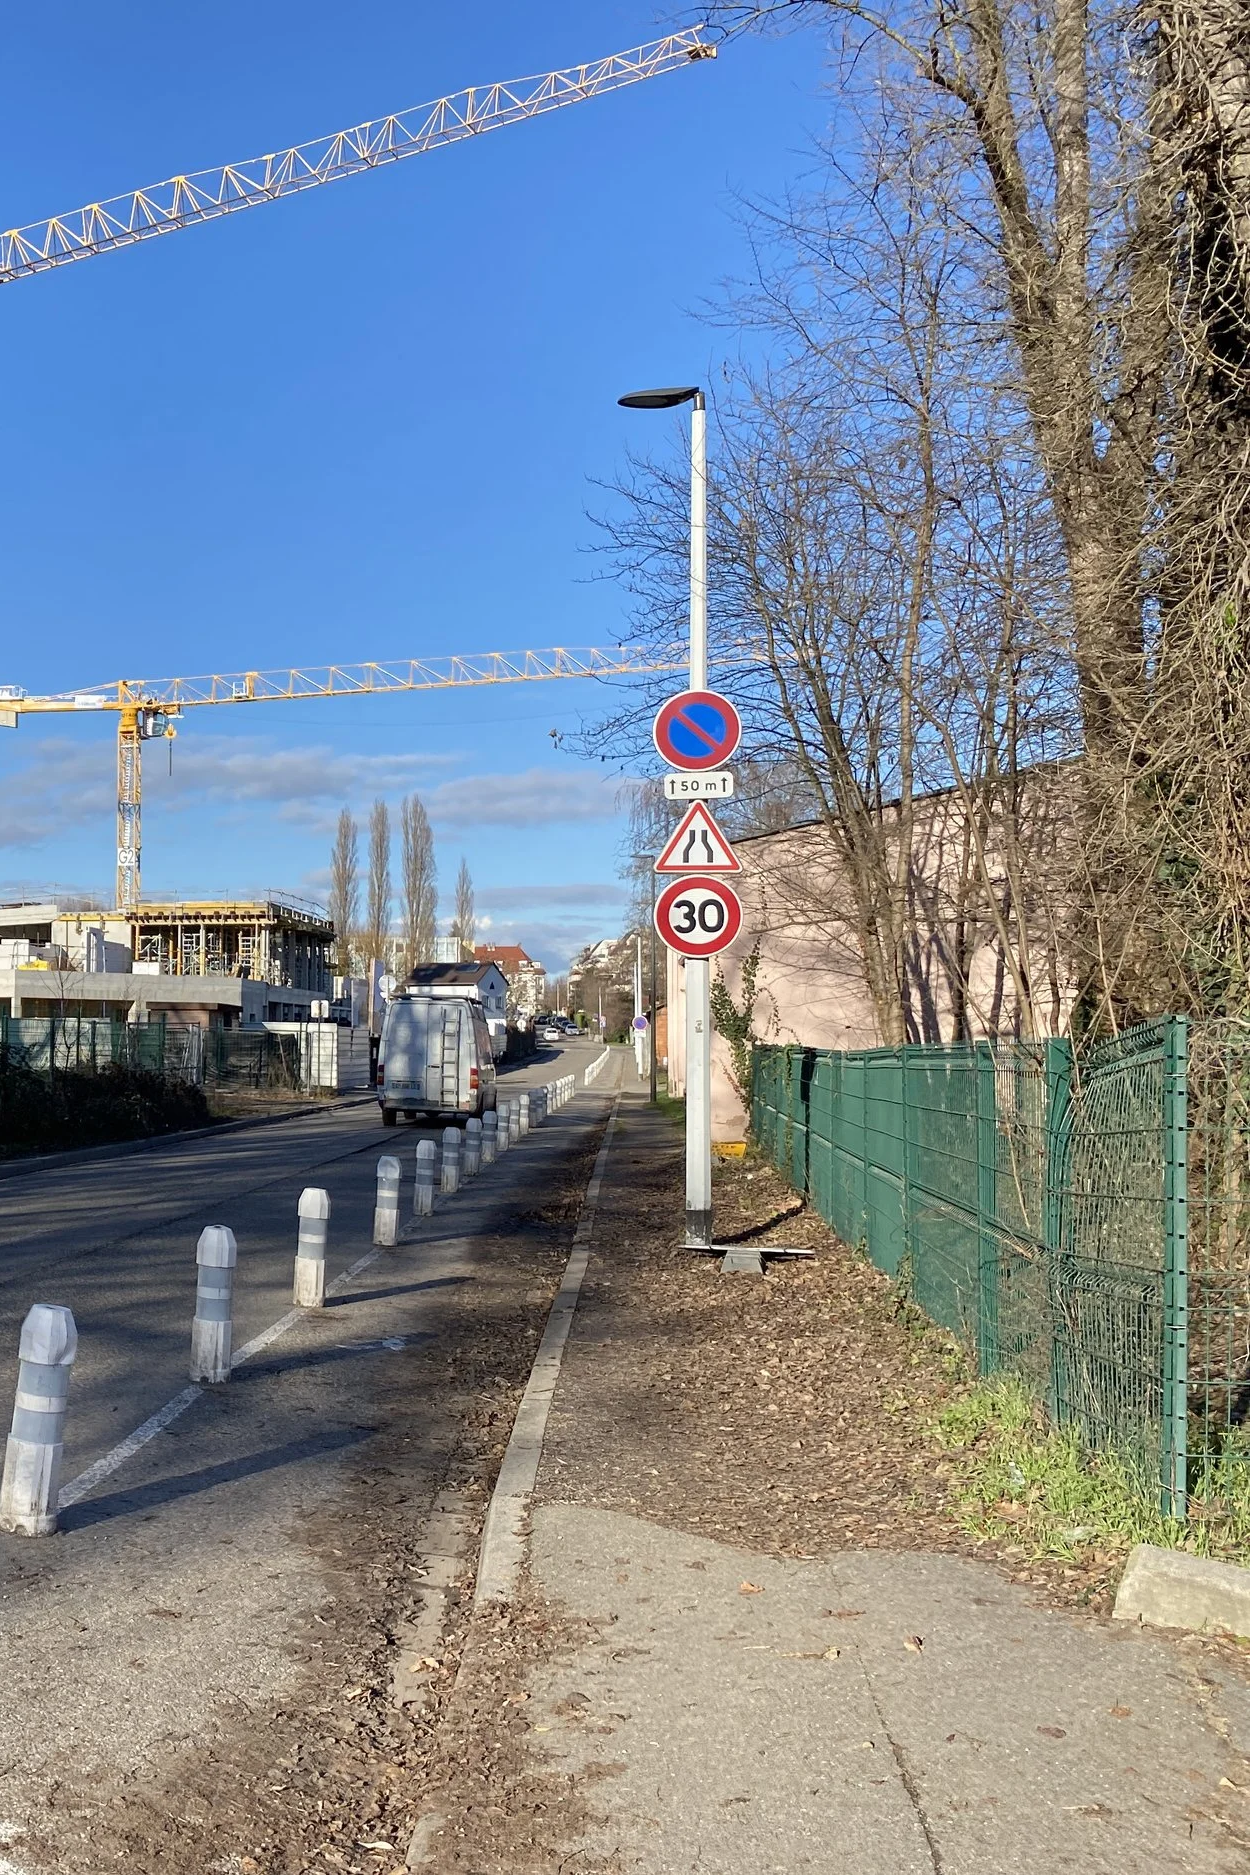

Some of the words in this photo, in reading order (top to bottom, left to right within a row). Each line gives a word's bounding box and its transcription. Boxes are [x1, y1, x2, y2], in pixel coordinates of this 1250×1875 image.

[681, 780, 700, 791] 50
[705, 782, 717, 791] m
[118, 849, 134, 864] G2
[673, 898, 725, 934] 30
